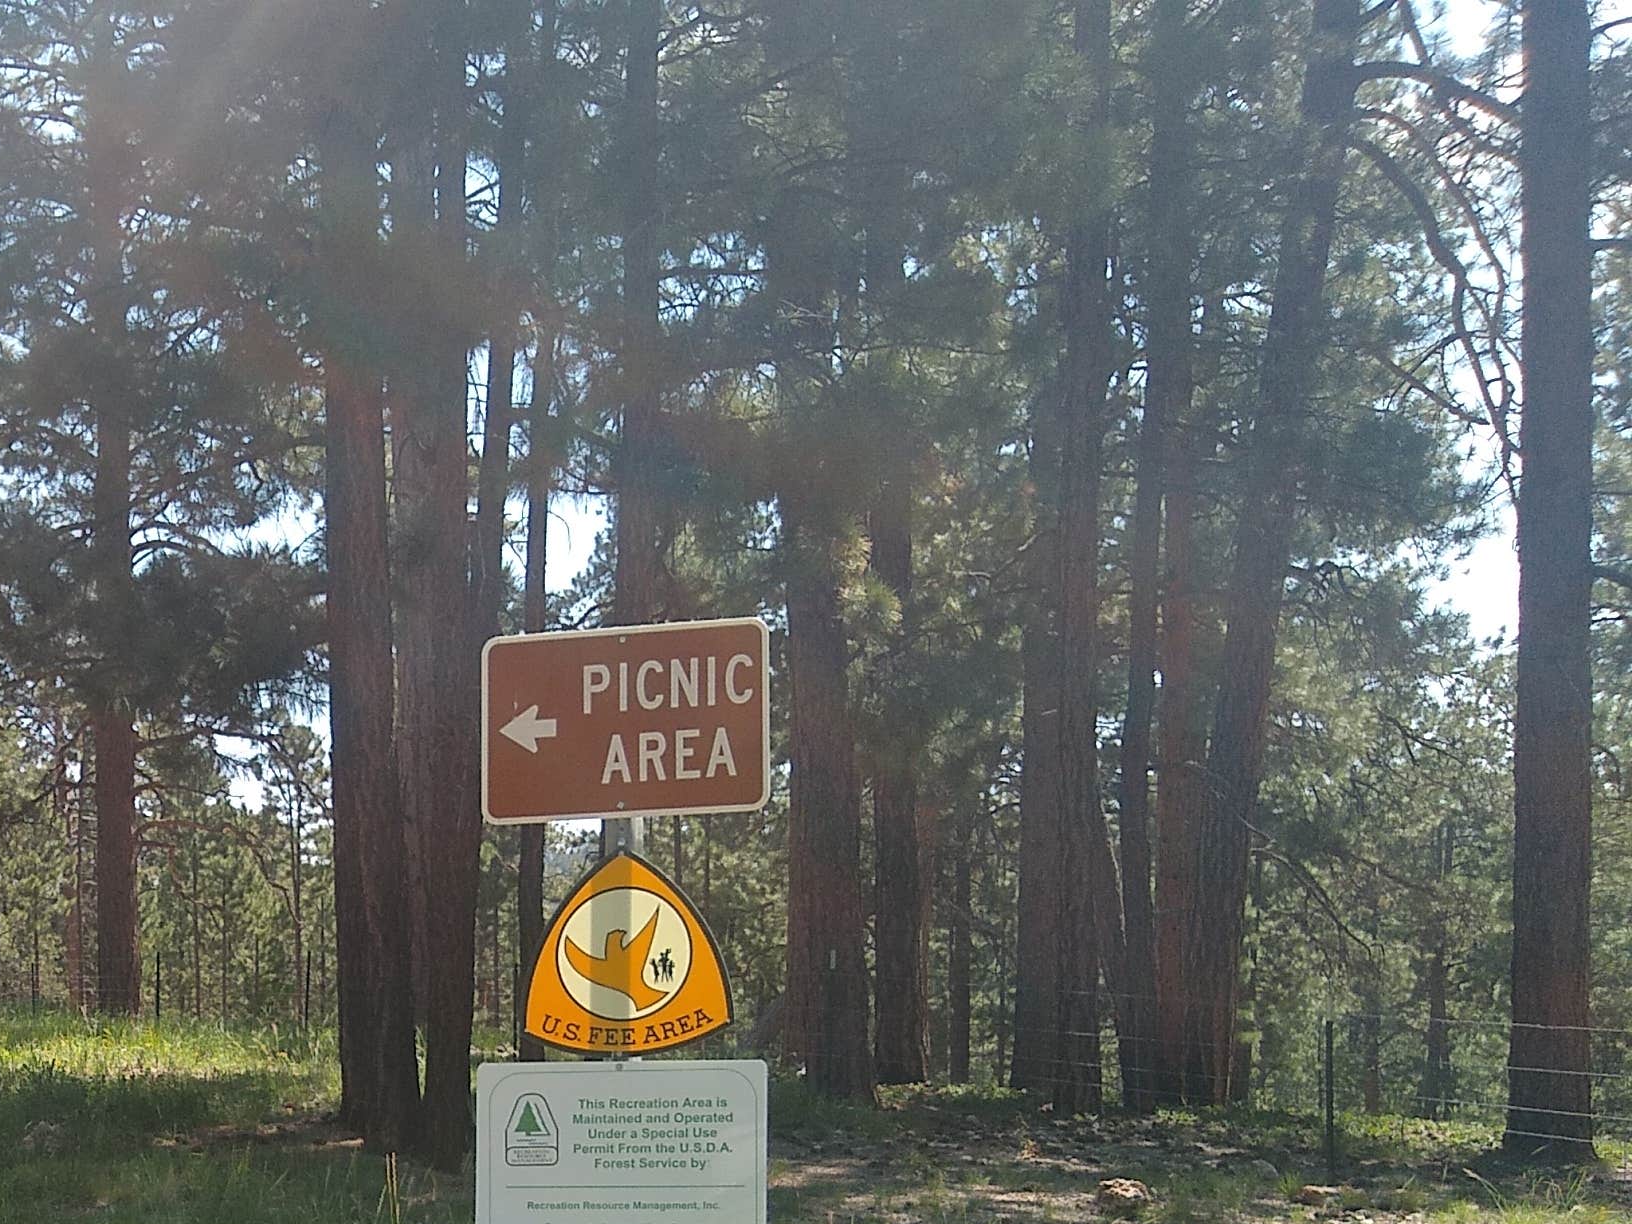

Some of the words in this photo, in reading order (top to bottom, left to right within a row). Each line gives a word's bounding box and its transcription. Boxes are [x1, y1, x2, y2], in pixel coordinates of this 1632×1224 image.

[582, 653, 755, 714] PICNIC
[601, 727, 737, 784] AREA
[542, 1014, 580, 1042] U.S.
[587, 1027, 636, 1045] FEE
[643, 1008, 714, 1043] AREA
[579, 1099, 605, 1109] This
[609, 1098, 679, 1109] Recreation
[682, 1098, 712, 1108] Area
[717, 1098, 728, 1108] is
[572, 1113, 642, 1124] Maintained
[646, 1113, 670, 1124] and
[674, 1113, 733, 1126] Operated
[588, 1128, 626, 1139] Under
[642, 1128, 688, 1142] Special
[693, 1128, 717, 1138] Use
[573, 1143, 615, 1154] Permit
[618, 1143, 651, 1154] From
[656, 1143, 675, 1153] the
[680, 1143, 733, 1153] U.S.D.A.
[594, 1158, 635, 1169] Forest
[639, 1158, 687, 1169] Service
[527, 1202, 580, 1210] Recreation
[583, 1201, 630, 1209] Resource
[632, 1201, 700, 1211] Management,
[703, 1201, 720, 1209] Inc.
